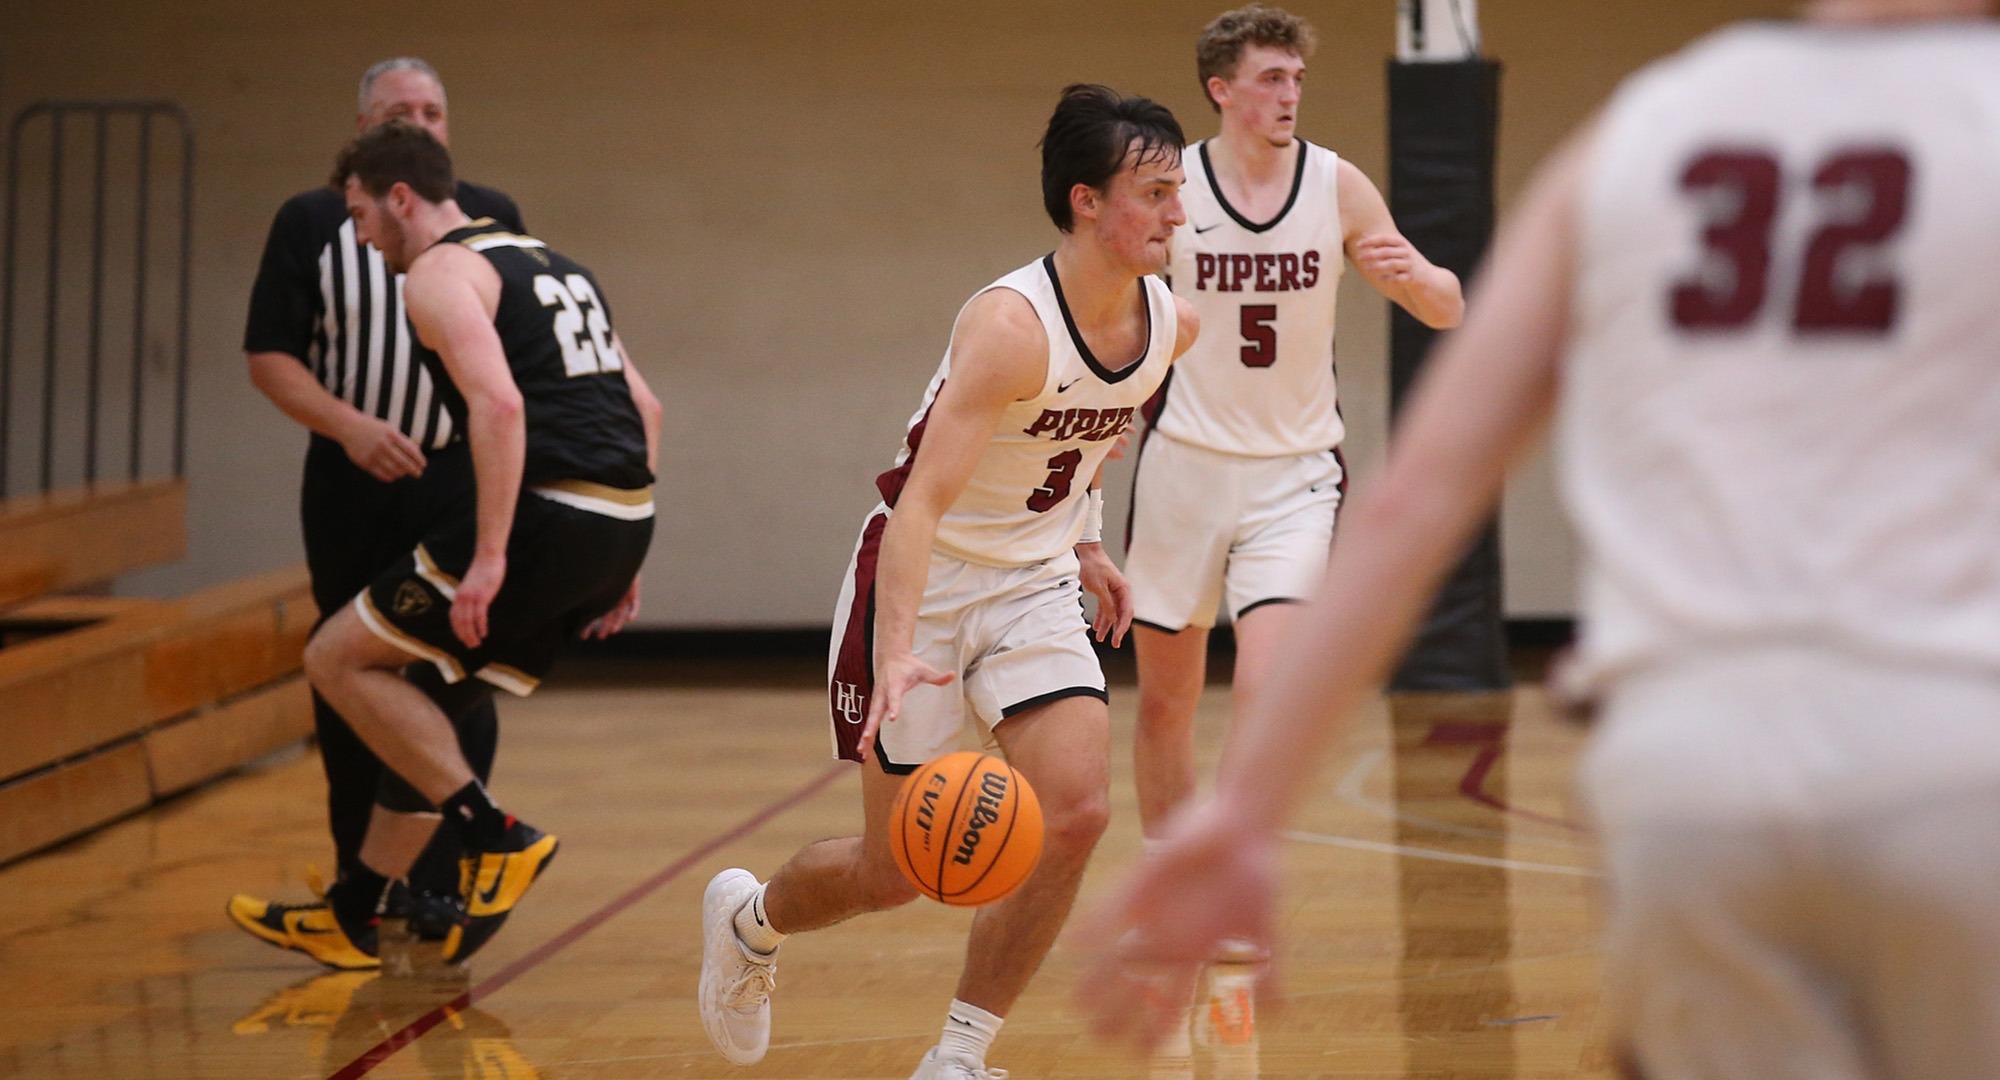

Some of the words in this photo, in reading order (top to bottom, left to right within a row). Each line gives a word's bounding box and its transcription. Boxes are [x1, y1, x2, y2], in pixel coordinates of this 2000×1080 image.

[1196, 250, 1320, 292] PIPERS
[1671, 147, 1911, 333] 32
[533, 273, 623, 378] 22
[1240, 304, 1277, 368] 5
[1023, 406, 1134, 442] PIPER
[1026, 448, 1082, 513] 3
[835, 680, 865, 724] HU
[917, 773, 947, 831] EVO
[952, 772, 1008, 866] Wilson
